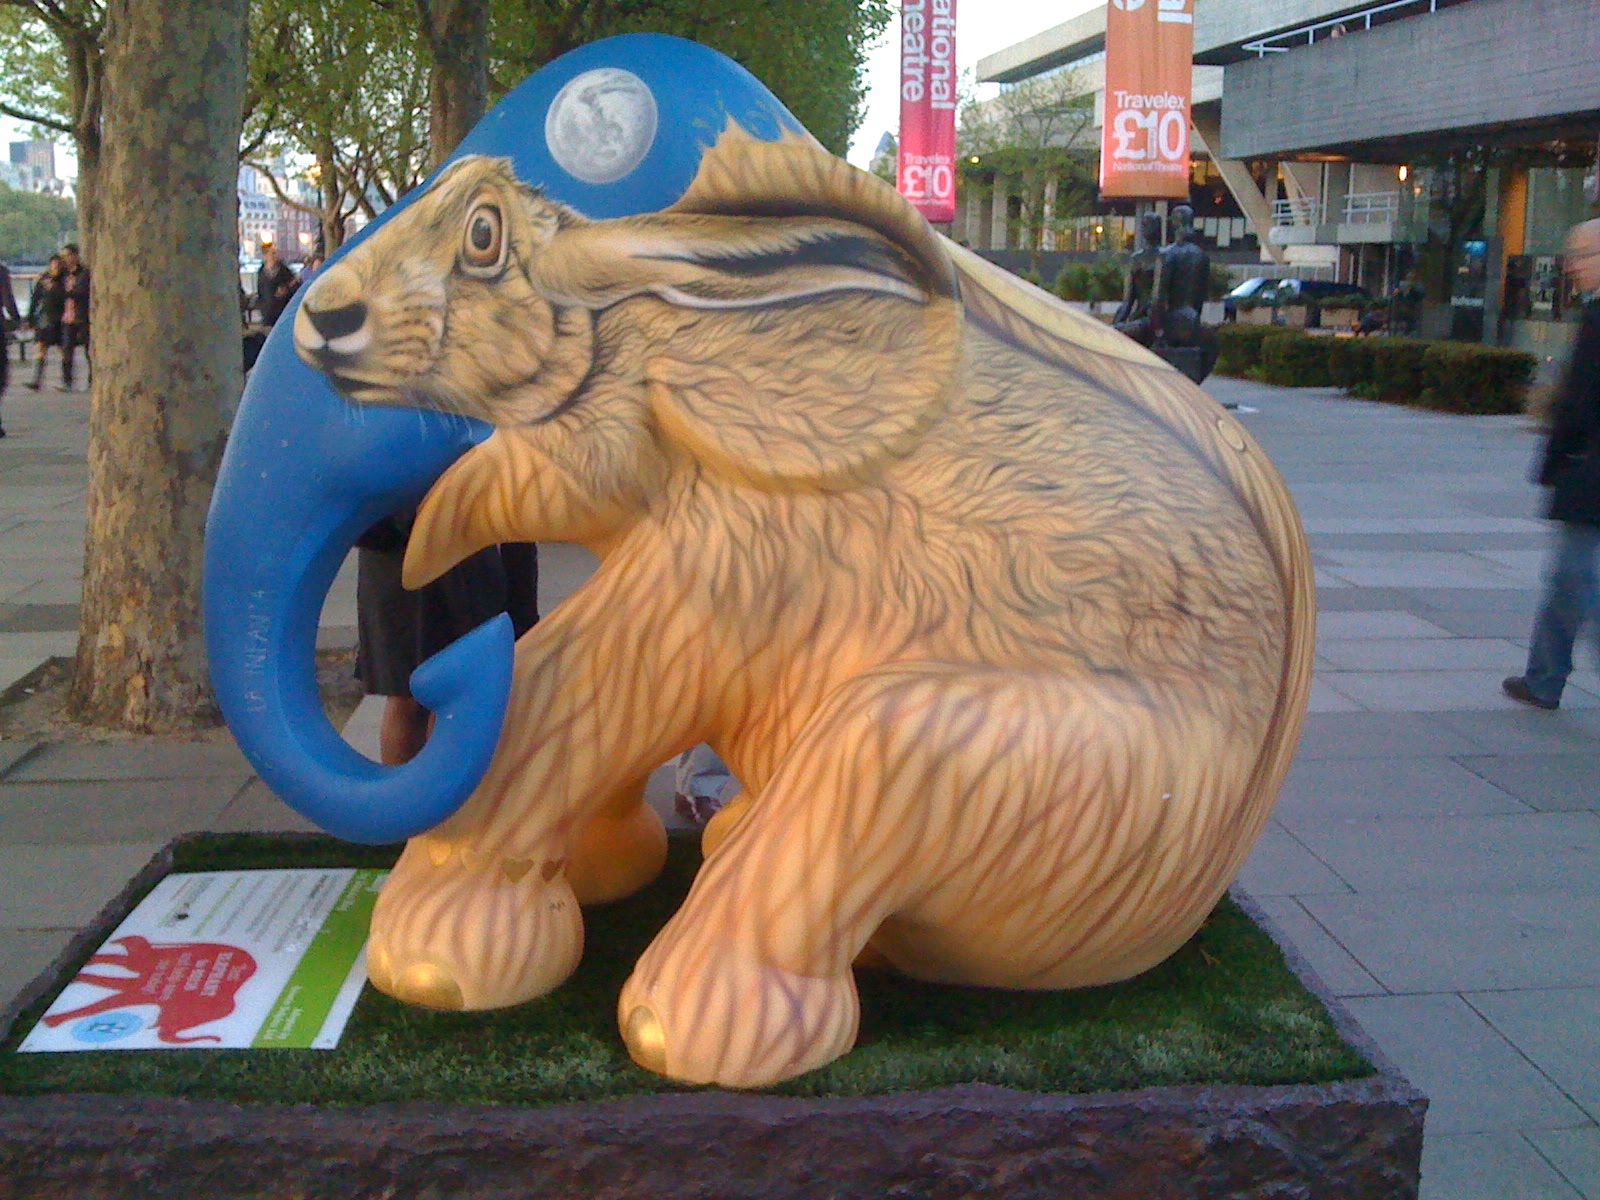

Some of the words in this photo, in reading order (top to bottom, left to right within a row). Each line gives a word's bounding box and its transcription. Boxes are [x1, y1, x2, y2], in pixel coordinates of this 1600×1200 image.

[1113, 91, 1186, 109] Travelex
[1112, 109, 1186, 160] £10
[903, 165, 953, 198] £10
